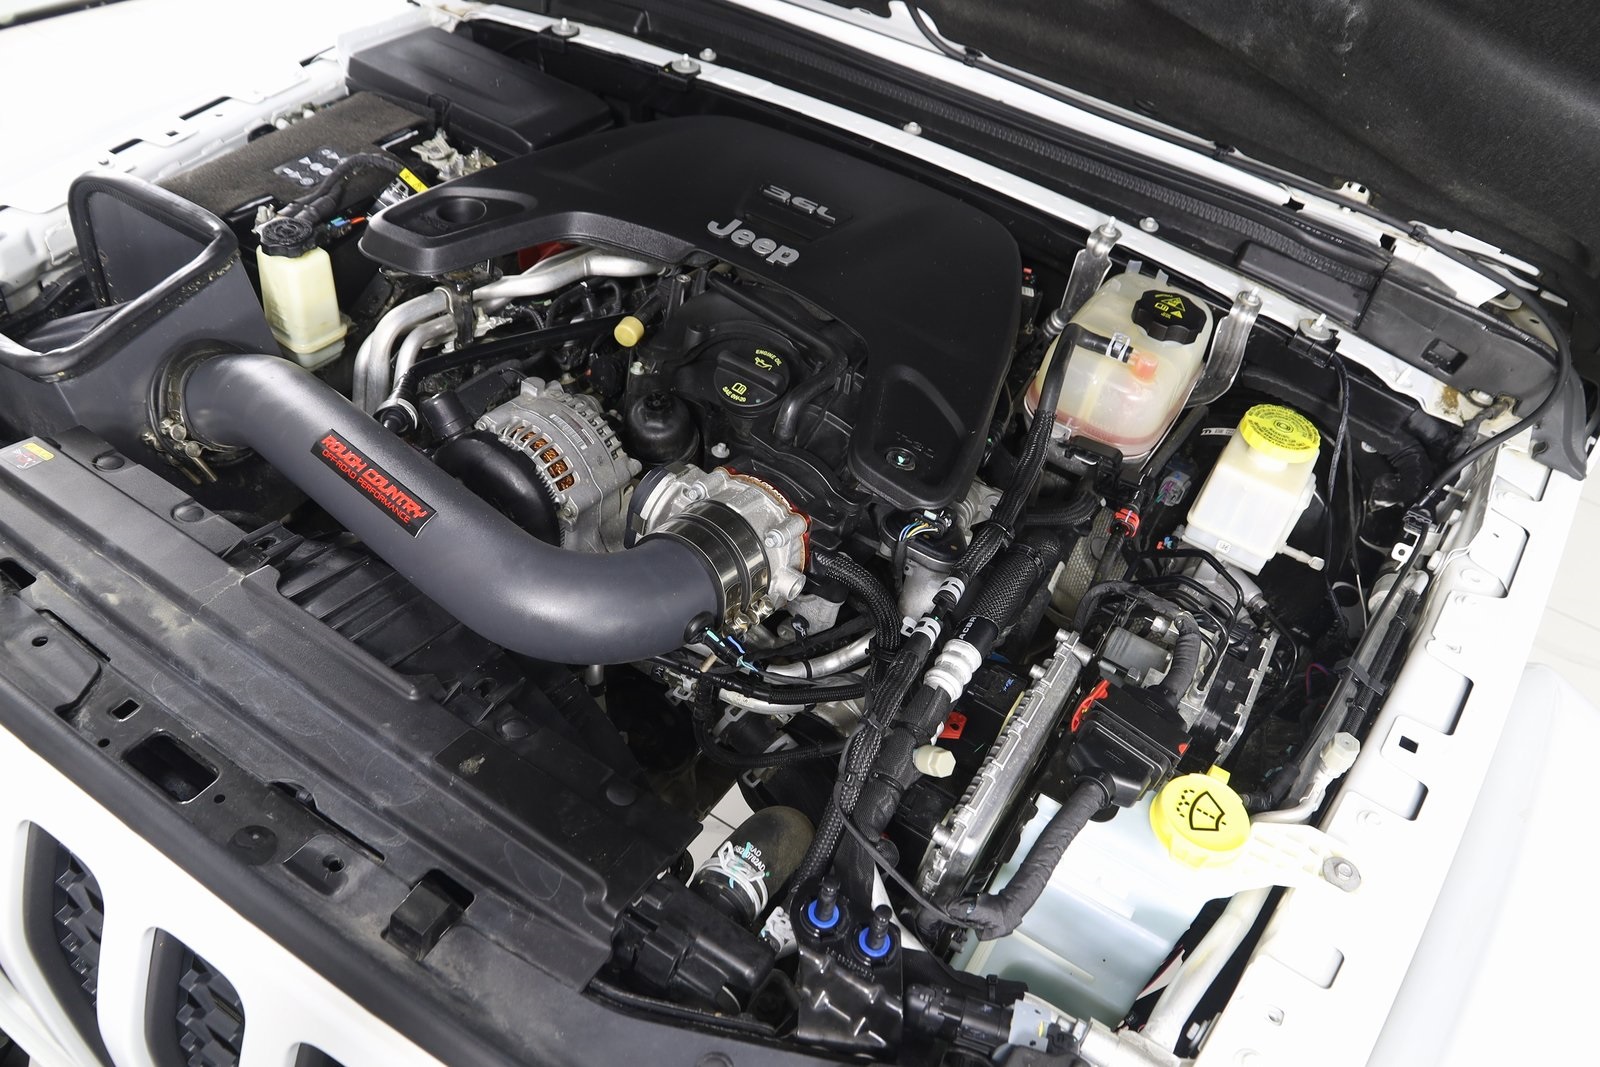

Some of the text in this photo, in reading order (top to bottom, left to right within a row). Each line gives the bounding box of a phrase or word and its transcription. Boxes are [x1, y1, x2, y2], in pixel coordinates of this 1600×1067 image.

[707, 218, 800, 267] Jeep
[755, 349, 777, 360] ENGINE
[321, 435, 428, 519] ROUGH COUNTRY
[321, 448, 412, 524] OFF-ROAD PERFORMANCE
